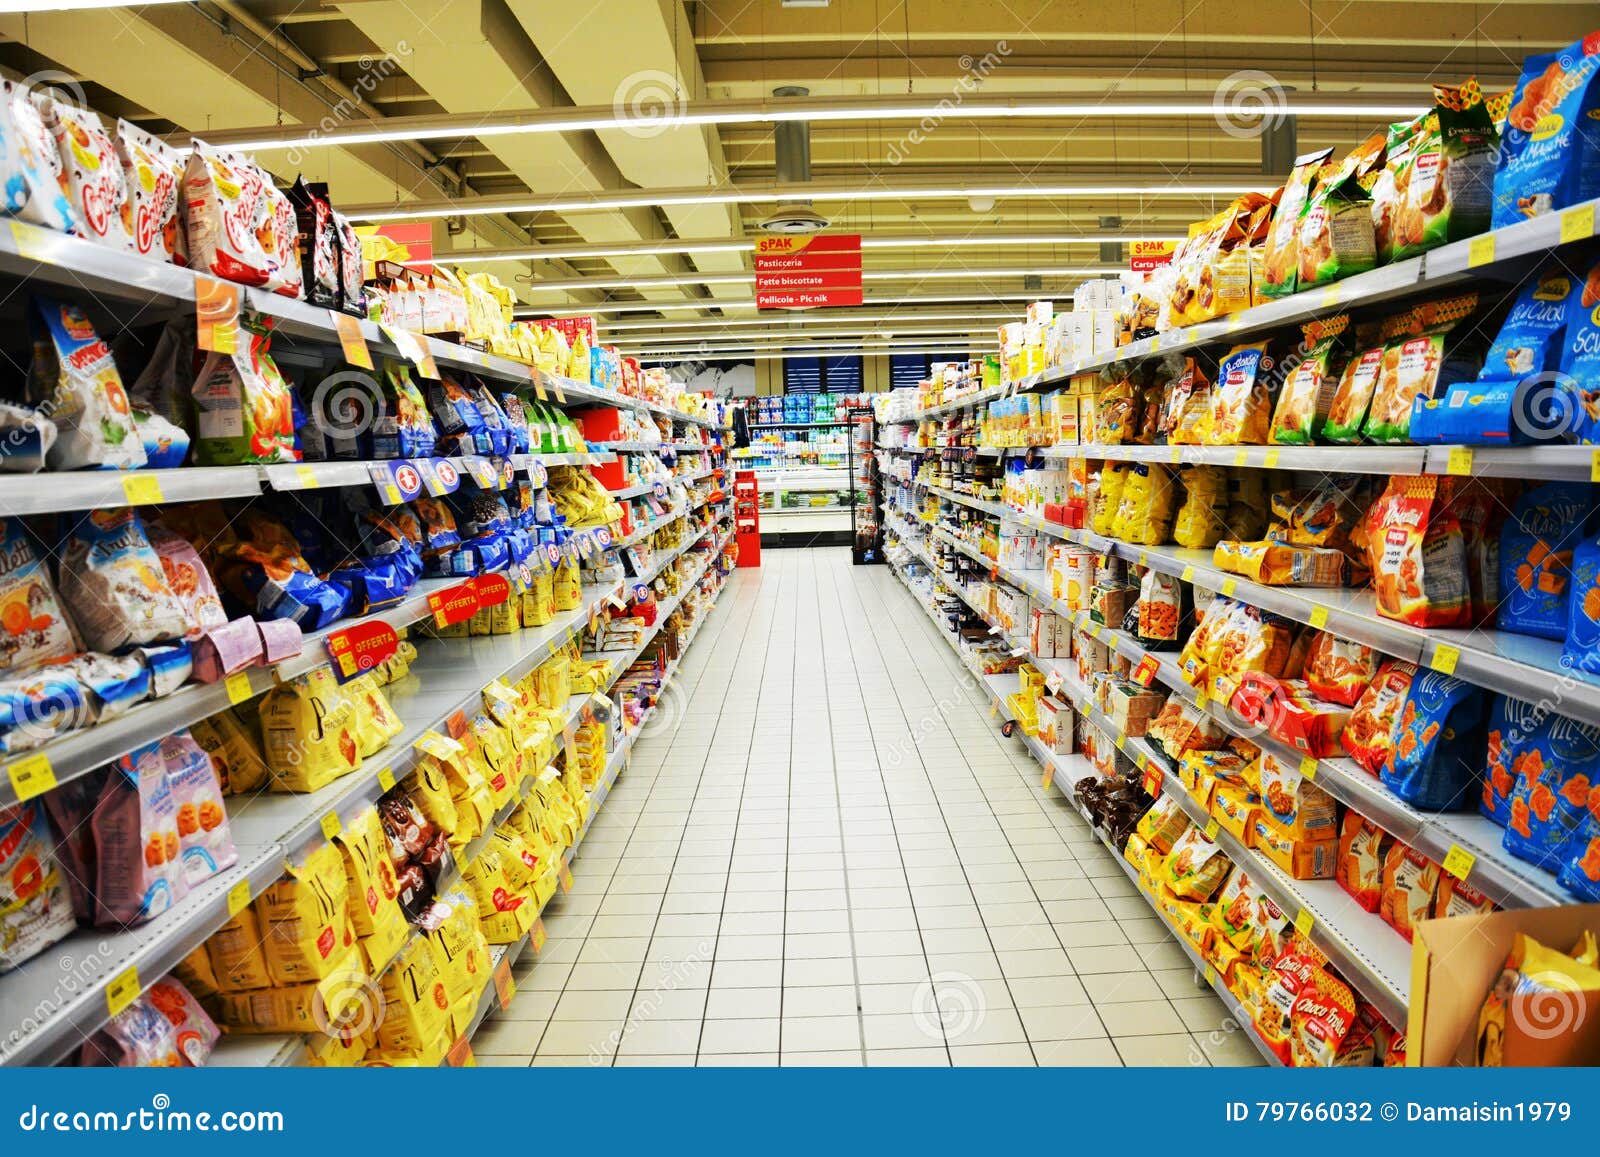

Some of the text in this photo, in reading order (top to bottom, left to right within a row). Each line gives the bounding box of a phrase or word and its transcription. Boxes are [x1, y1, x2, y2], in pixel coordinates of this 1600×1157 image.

[760, 238, 792, 252] SPAK
[1135, 241, 1164, 254] SPAK
[758, 259, 802, 267] Pasticceria
[759, 276, 822, 286] Fette biscottate
[759, 295, 794, 304] Pellicole
[800, 294, 813, 304] Pic
[814, 294, 828, 303] nik
[479, 584, 507, 598] OFFERTA
[445, 597, 477, 612] OFFERTA
[355, 633, 395, 653] OFFERTA
[1296, 998, 1328, 1018] Choco
